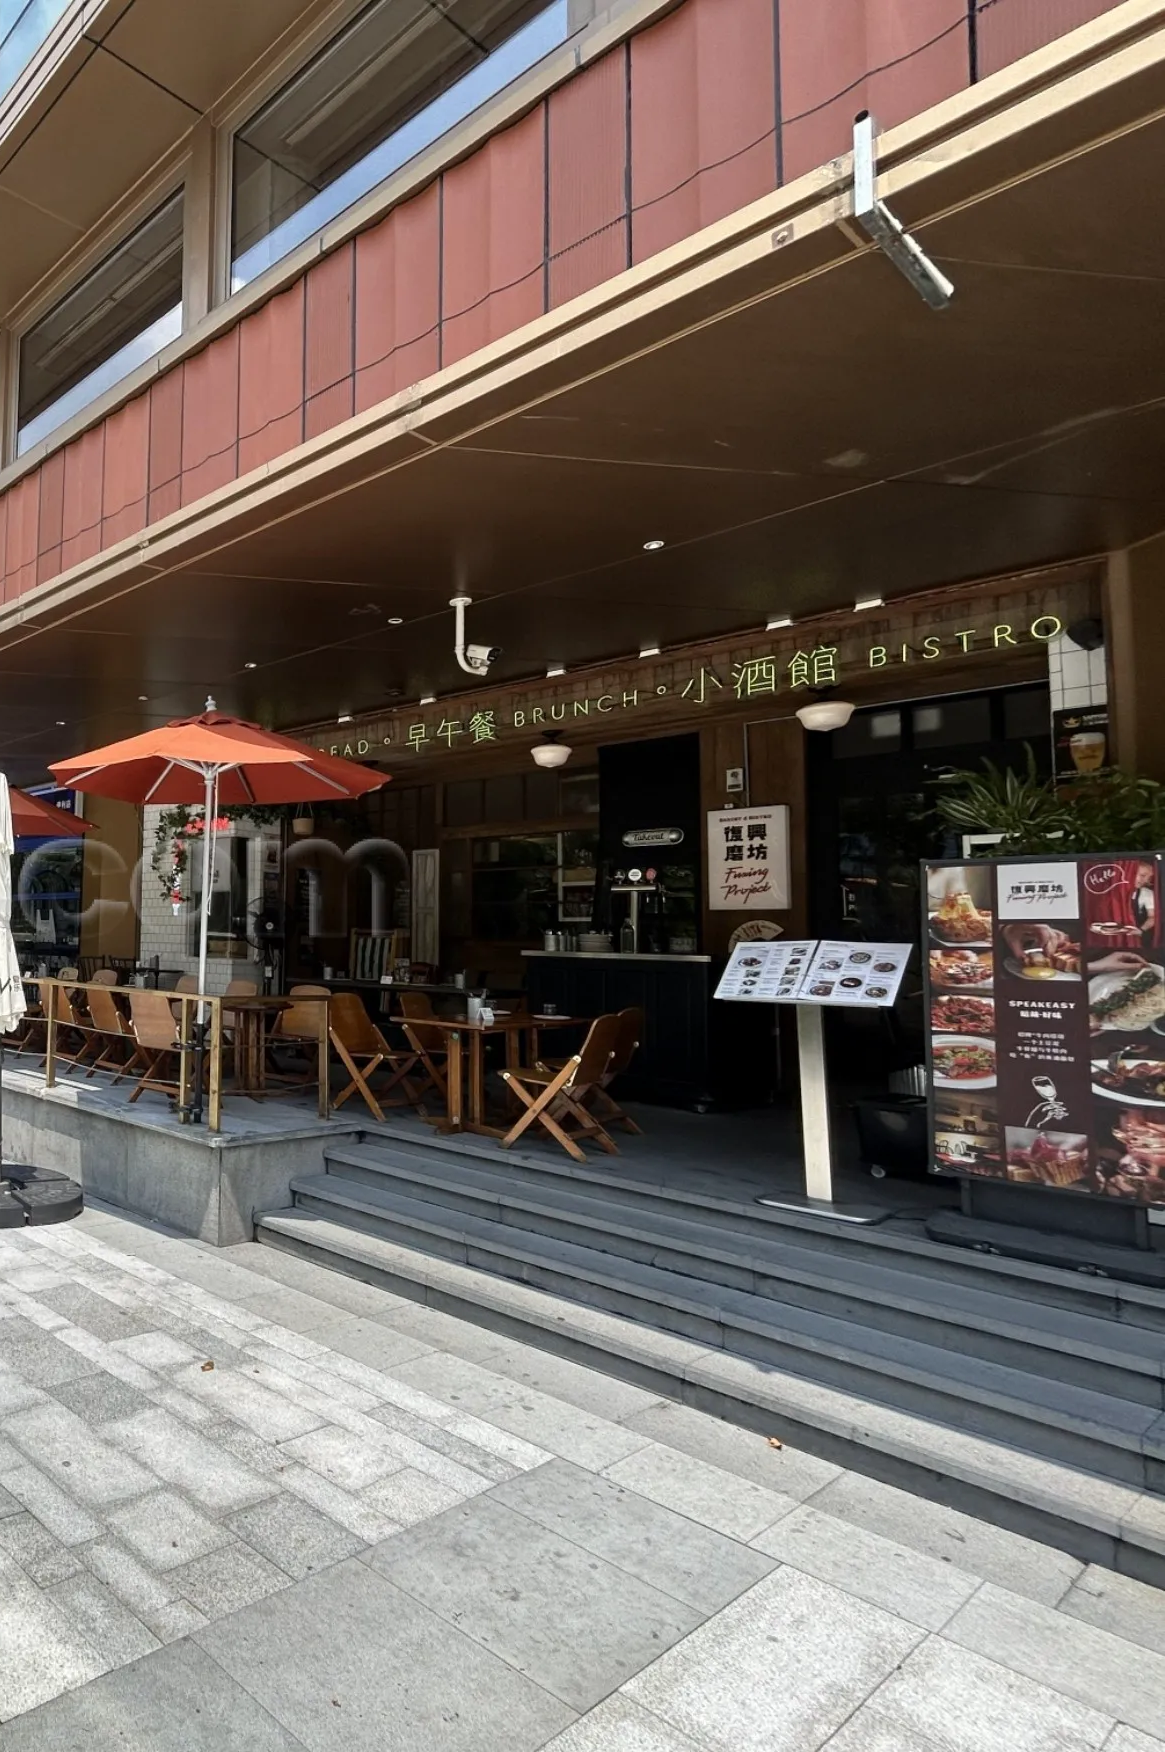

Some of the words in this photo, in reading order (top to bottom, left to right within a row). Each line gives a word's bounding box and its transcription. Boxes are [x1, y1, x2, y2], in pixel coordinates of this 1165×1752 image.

[319, 740, 369, 756] EAD
[405, 710, 496, 752] 早午餐
[514, 689, 638, 727] BRUNCH
[681, 646, 838, 703] 小酒館
[869, 616, 1062, 668] BISTRO
[1089, 869, 1116, 885] Hello
[720, 881, 772, 905] Project
[1009, 1000, 1075, 1009] SPEAKEASY
